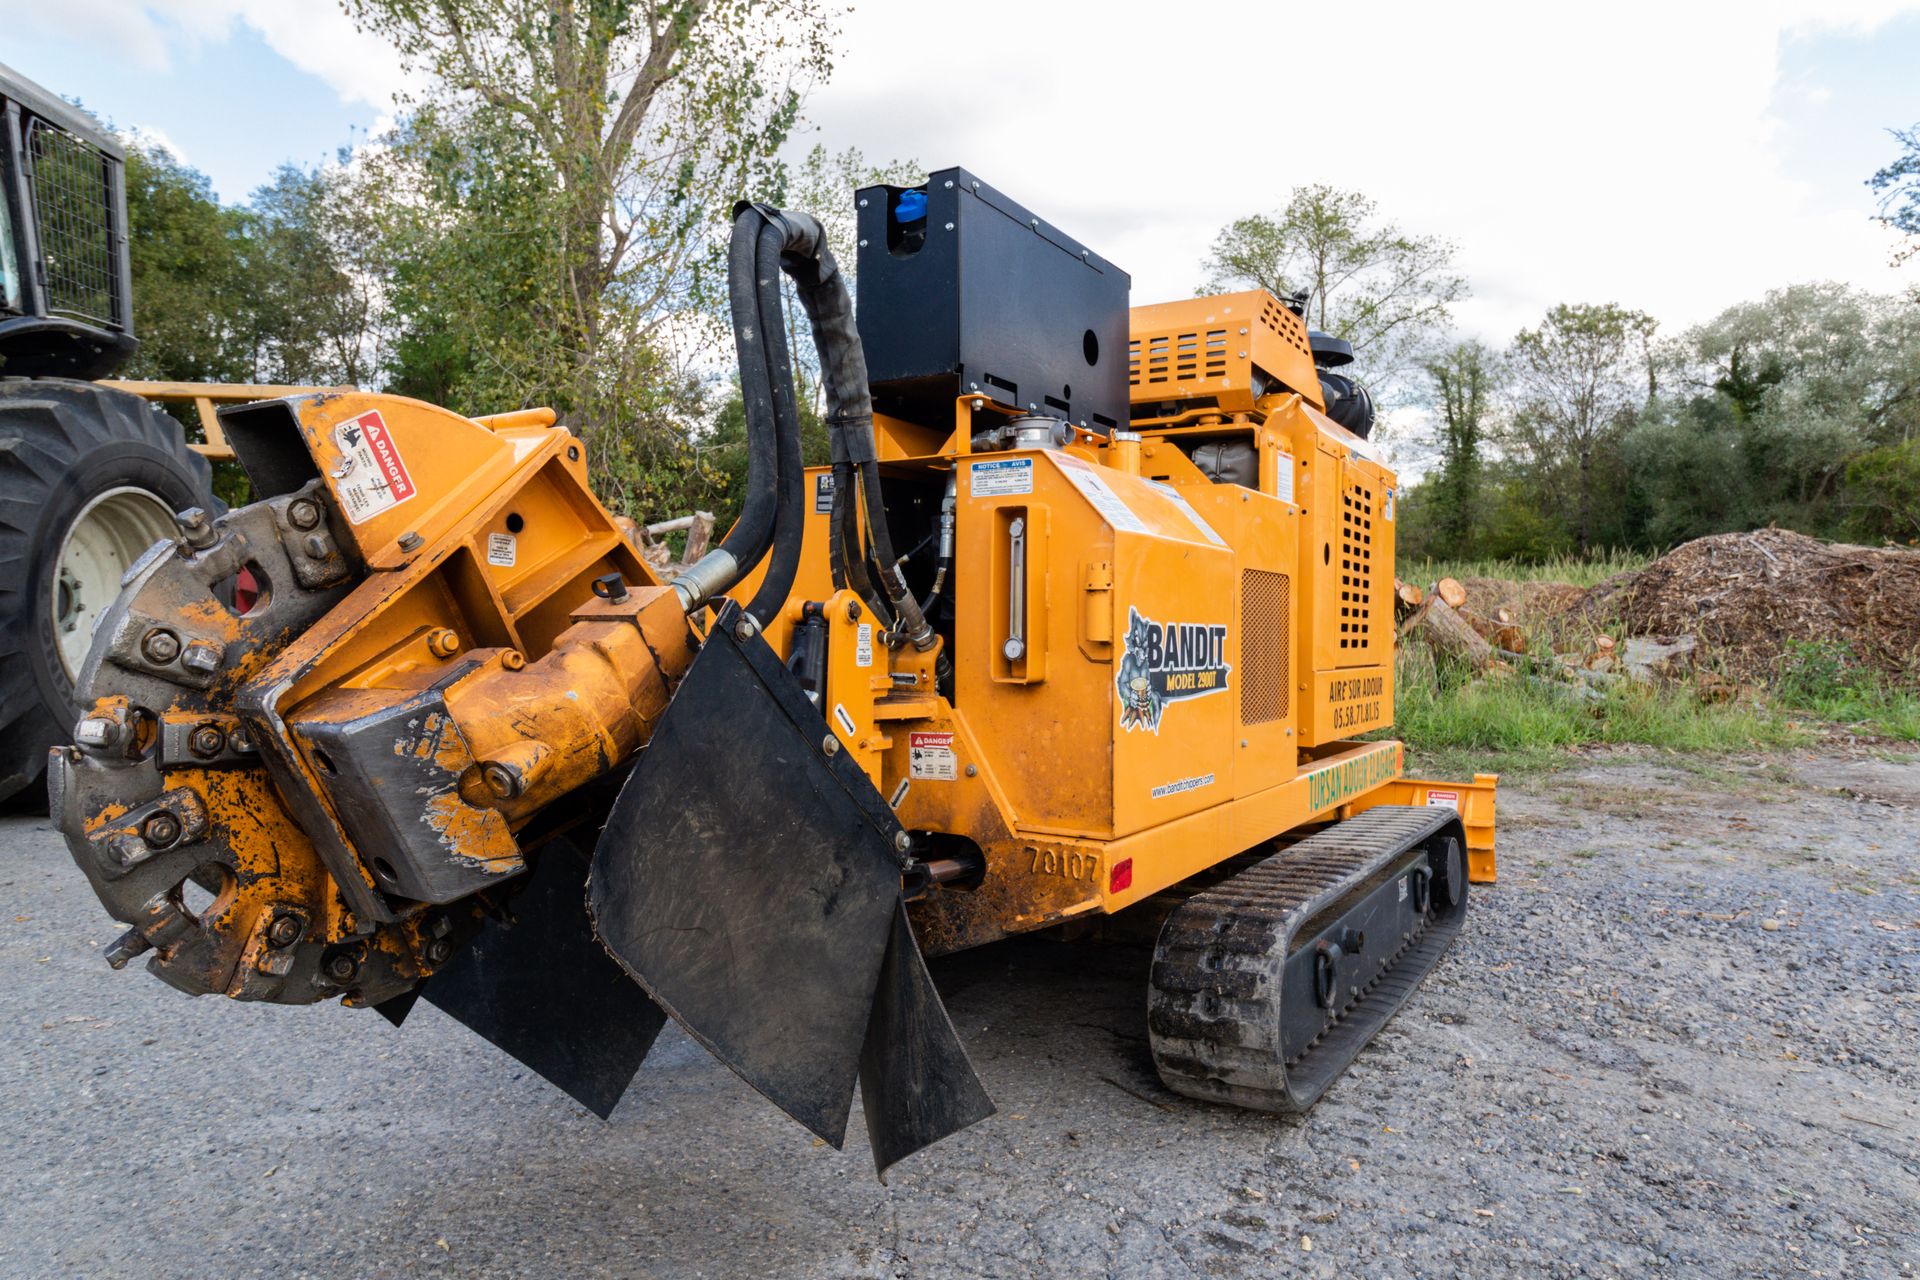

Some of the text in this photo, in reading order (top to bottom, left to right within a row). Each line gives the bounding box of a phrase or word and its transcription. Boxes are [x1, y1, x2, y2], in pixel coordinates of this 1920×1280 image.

[375, 439, 407, 494] DANGER
[1147, 624, 1226, 669] BANDIT
[1166, 671, 1217, 691] MODEL 2900T
[1329, 677, 1383, 703] AIRE SUR ADOUR
[1333, 701, 1380, 729] 05.58.71.81.15
[1151, 773, 1215, 798] www.banditchippers.com
[1308, 765, 1342, 814] TURSAN
[1343, 755, 1368, 798] ADOUR
[1024, 845, 1100, 882] 70107
